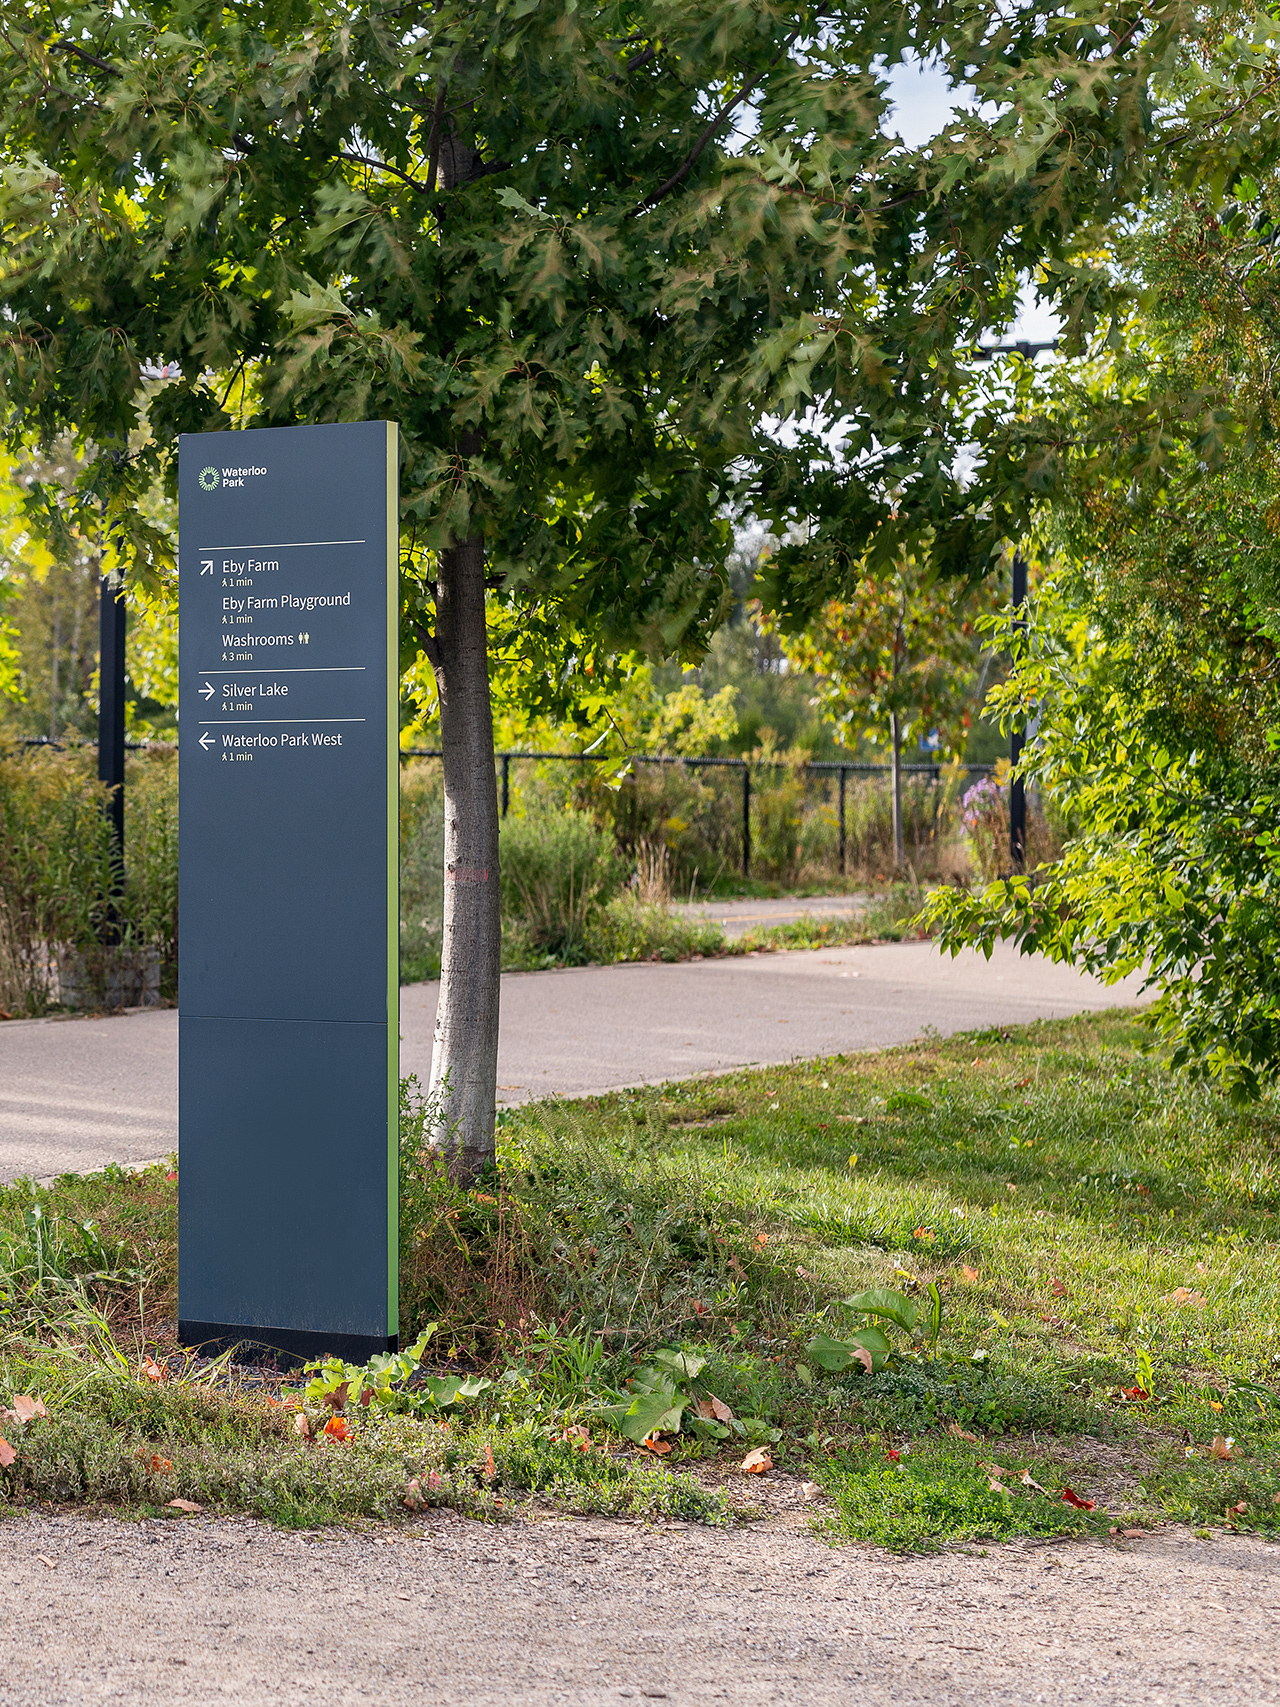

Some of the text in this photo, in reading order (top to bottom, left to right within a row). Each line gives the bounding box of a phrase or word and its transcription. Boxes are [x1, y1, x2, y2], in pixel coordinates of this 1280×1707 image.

[221, 465, 268, 476] Waterloo
[222, 476, 245, 488] Park
[222, 559, 279, 575] Eby Farm
[236, 576, 253, 586] min
[222, 591, 351, 612] Eby Farm Playground
[235, 613, 253, 623] min
[221, 632, 295, 647] Washrooms
[236, 650, 253, 660] min
[222, 682, 289, 697] Silver Lake
[236, 700, 253, 710] min
[221, 732, 343, 747] Waterloo Park West
[236, 751, 253, 761] min
